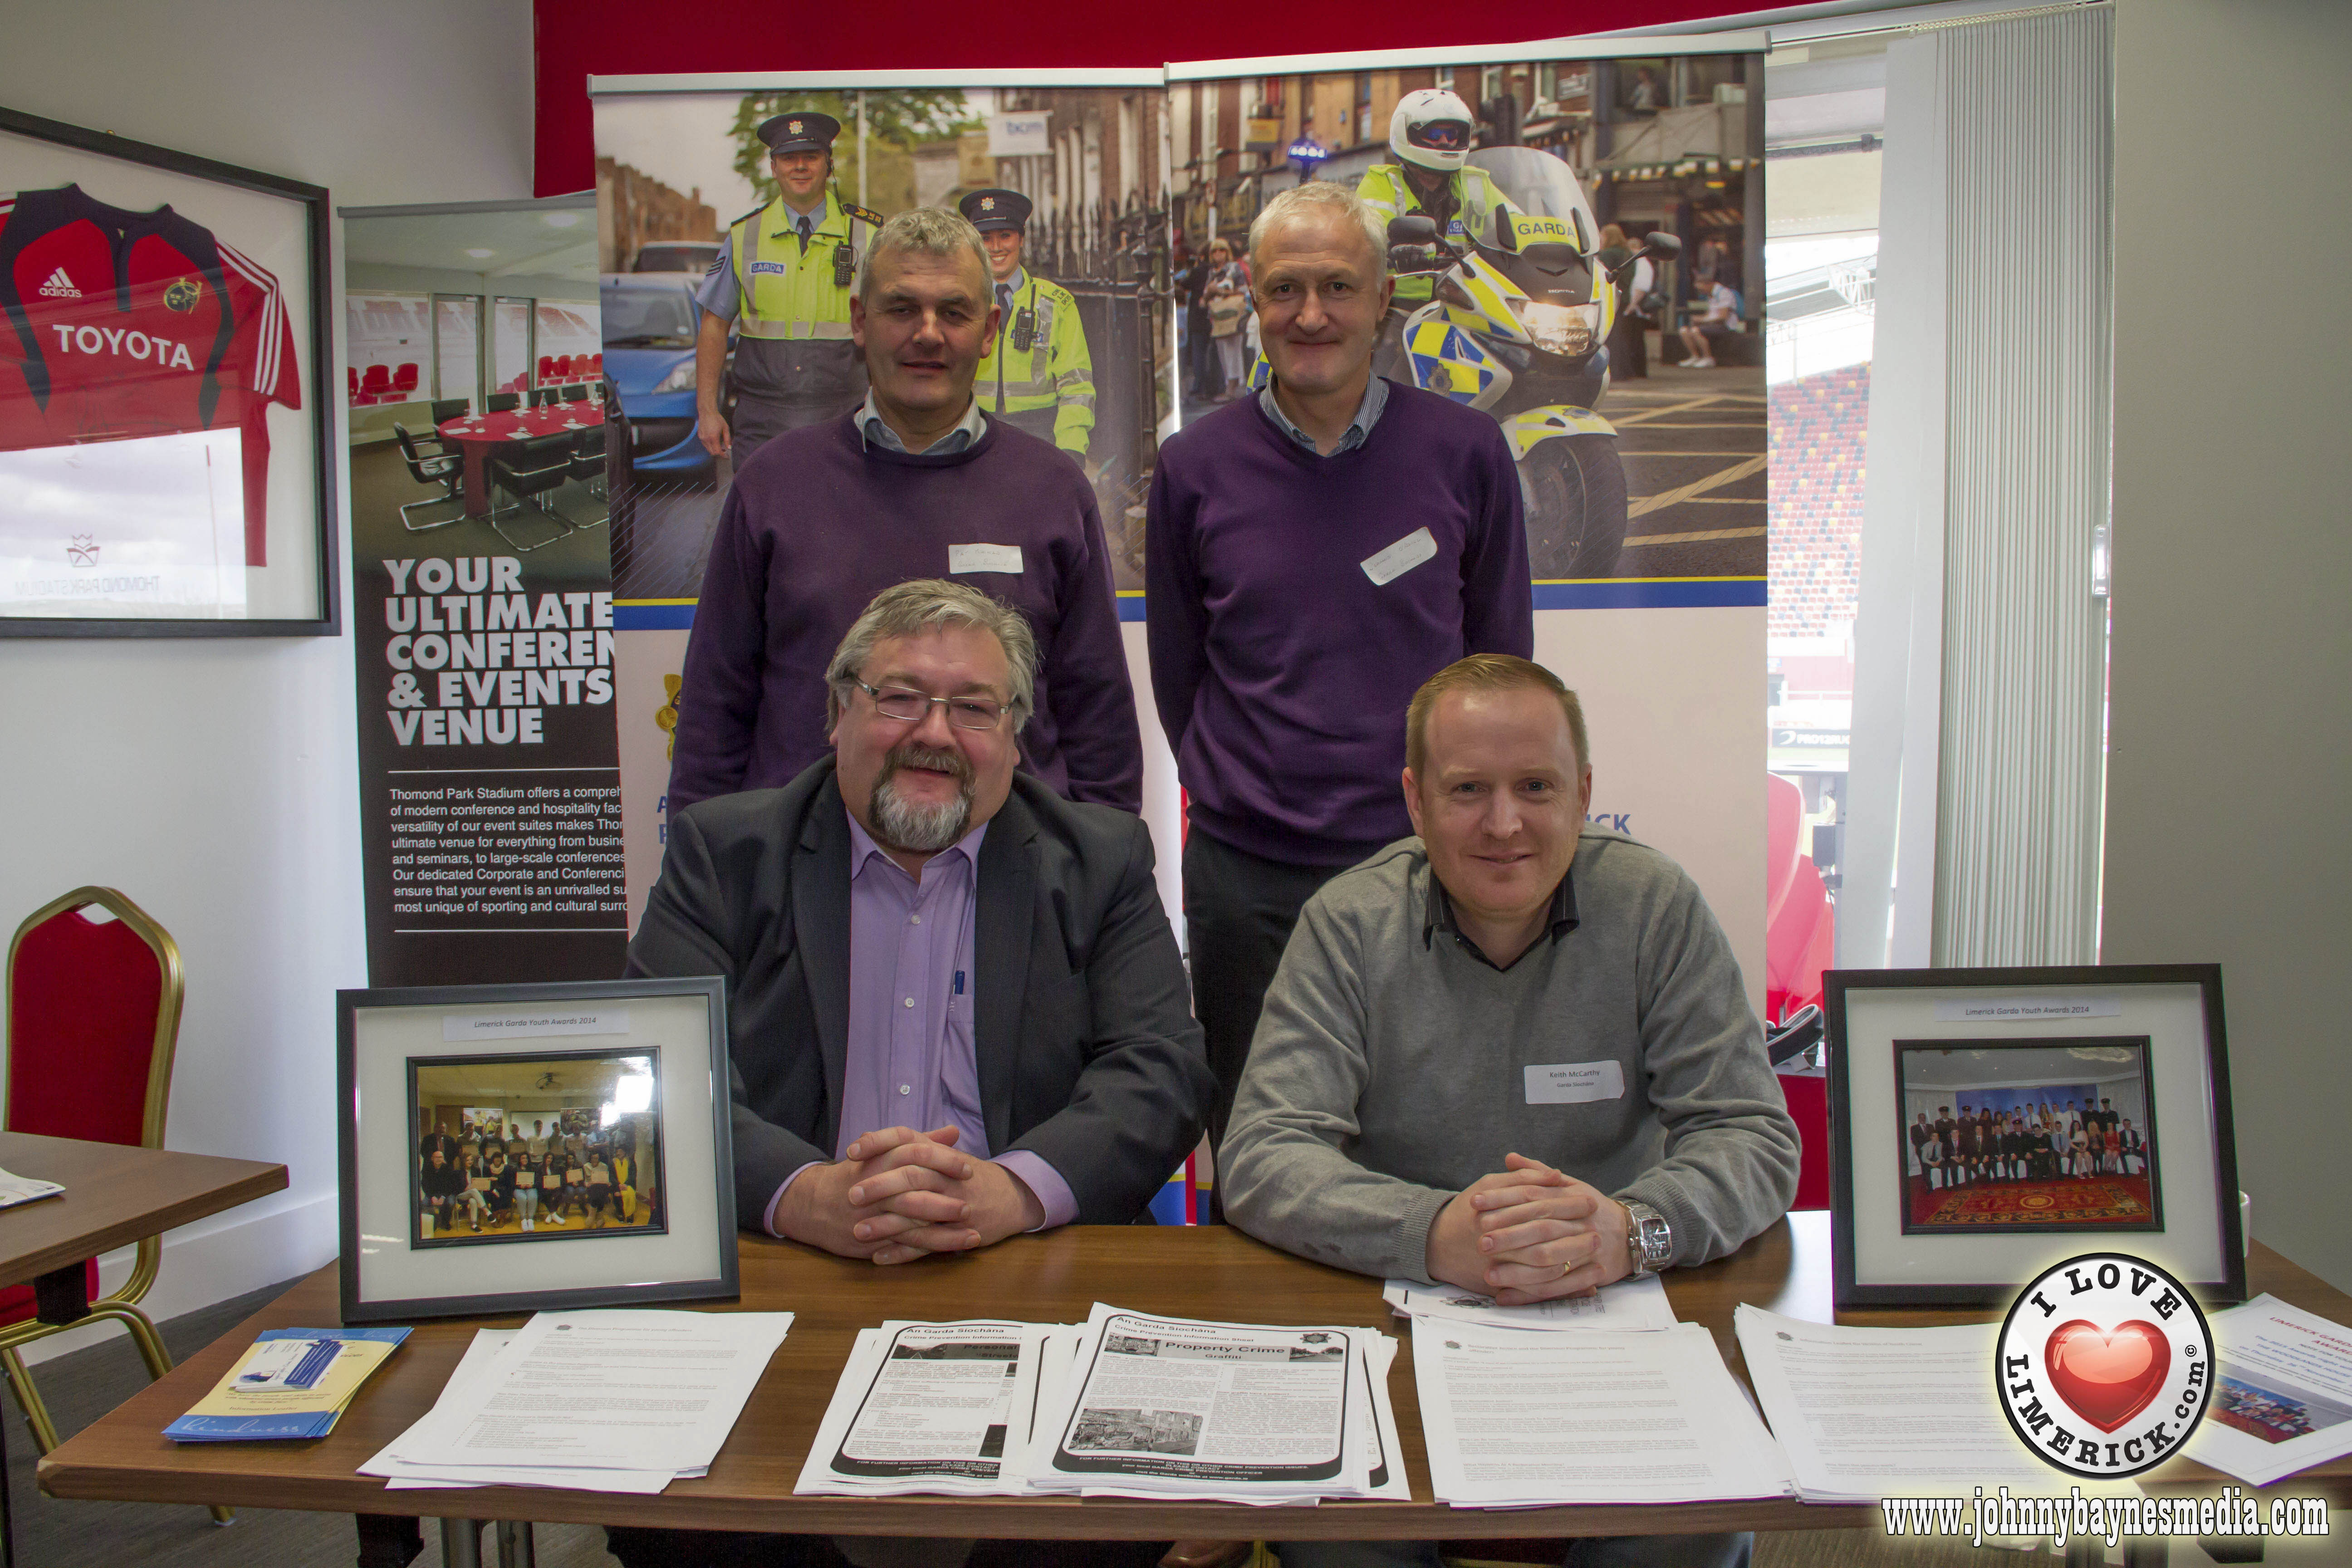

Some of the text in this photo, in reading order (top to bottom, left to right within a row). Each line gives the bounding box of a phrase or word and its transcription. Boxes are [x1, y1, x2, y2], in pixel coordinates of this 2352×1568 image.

[1518, 223, 1576, 238] GARDA
[752, 263, 782, 273] GARDA
[39, 285, 82, 299] adidas
[53, 324, 194, 371] TOYOTA
[383, 557, 524, 595] YOUR
[386, 592, 613, 632] ULTIMATE
[388, 669, 613, 708] & EVENTS
[388, 708, 544, 745] VENUE
[390, 789, 443, 799] Thomond
[447, 788, 474, 799] Park
[477, 787, 524, 799] Stadium
[528, 787, 559, 798] offers
[564, 789, 570, 797] a
[391, 803, 621, 816] of modern conference and hospitality fac
[391, 821, 444, 833] versatility
[447, 821, 458, 831] of
[462, 823, 480, 831] our
[484, 820, 515, 830] event
[519, 820, 553, 830] suites
[556, 819, 594, 829] makes
[392, 835, 624, 848] ultimate venue for everything from busine
[393, 851, 625, 865] and seminars, to large-scale conferences
[393, 867, 624, 881] Our dedicated Corporate and Conferenci
[394, 884, 627, 897] ensure that your event is an unrivalled su
[395, 900, 628, 914] most unique of sporting and cultural surro
[1115, 1324, 1137, 1333] Crime
[1140, 1329, 1182, 1338] Prevention
[1135, 1322, 1165, 1330] Garda
[2270, 1317, 2319, 1335] LIMERICK
[1165, 1342, 1232, 1353] Property
[181, 1417, 300, 1434] kindness
